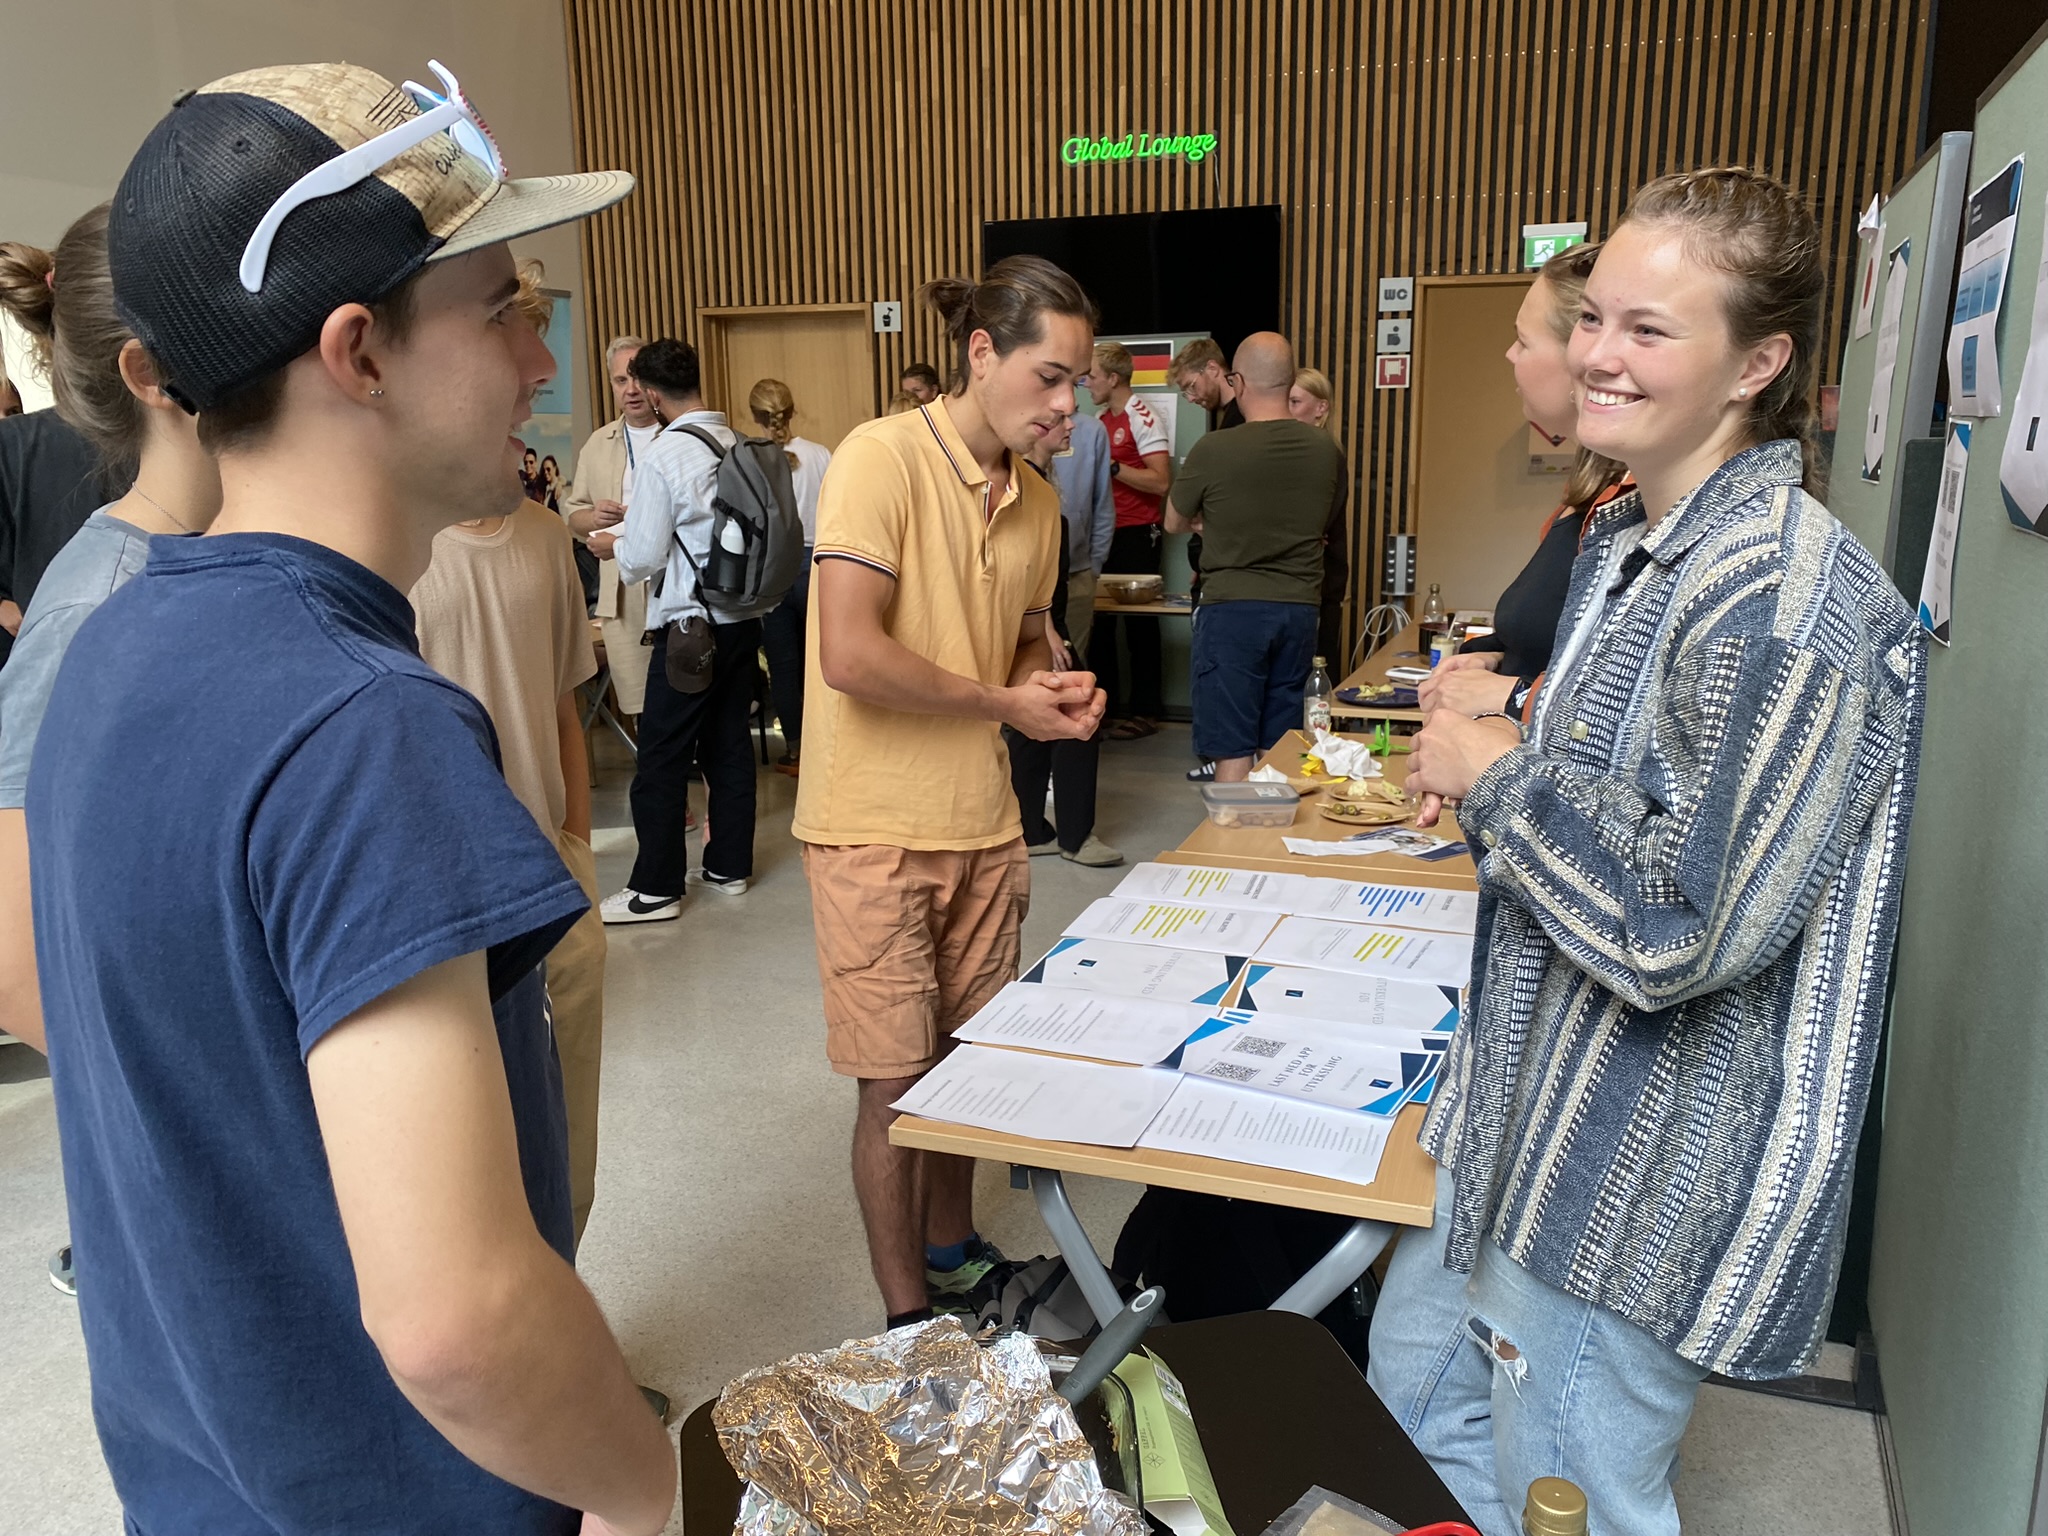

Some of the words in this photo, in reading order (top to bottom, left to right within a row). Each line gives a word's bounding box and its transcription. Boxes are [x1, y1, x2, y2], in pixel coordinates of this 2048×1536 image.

[1062, 133, 1134, 164] Global
[1136, 133, 1218, 161] Lounge
[1384, 288, 1408, 301] WC
[1267, 1073, 1289, 1087] LAST
[1284, 1059, 1302, 1073] NED
[1298, 1046, 1313, 1059] APP
[1298, 1063, 1318, 1077] FOR
[1300, 1056, 1343, 1093] UTVEKSLING
